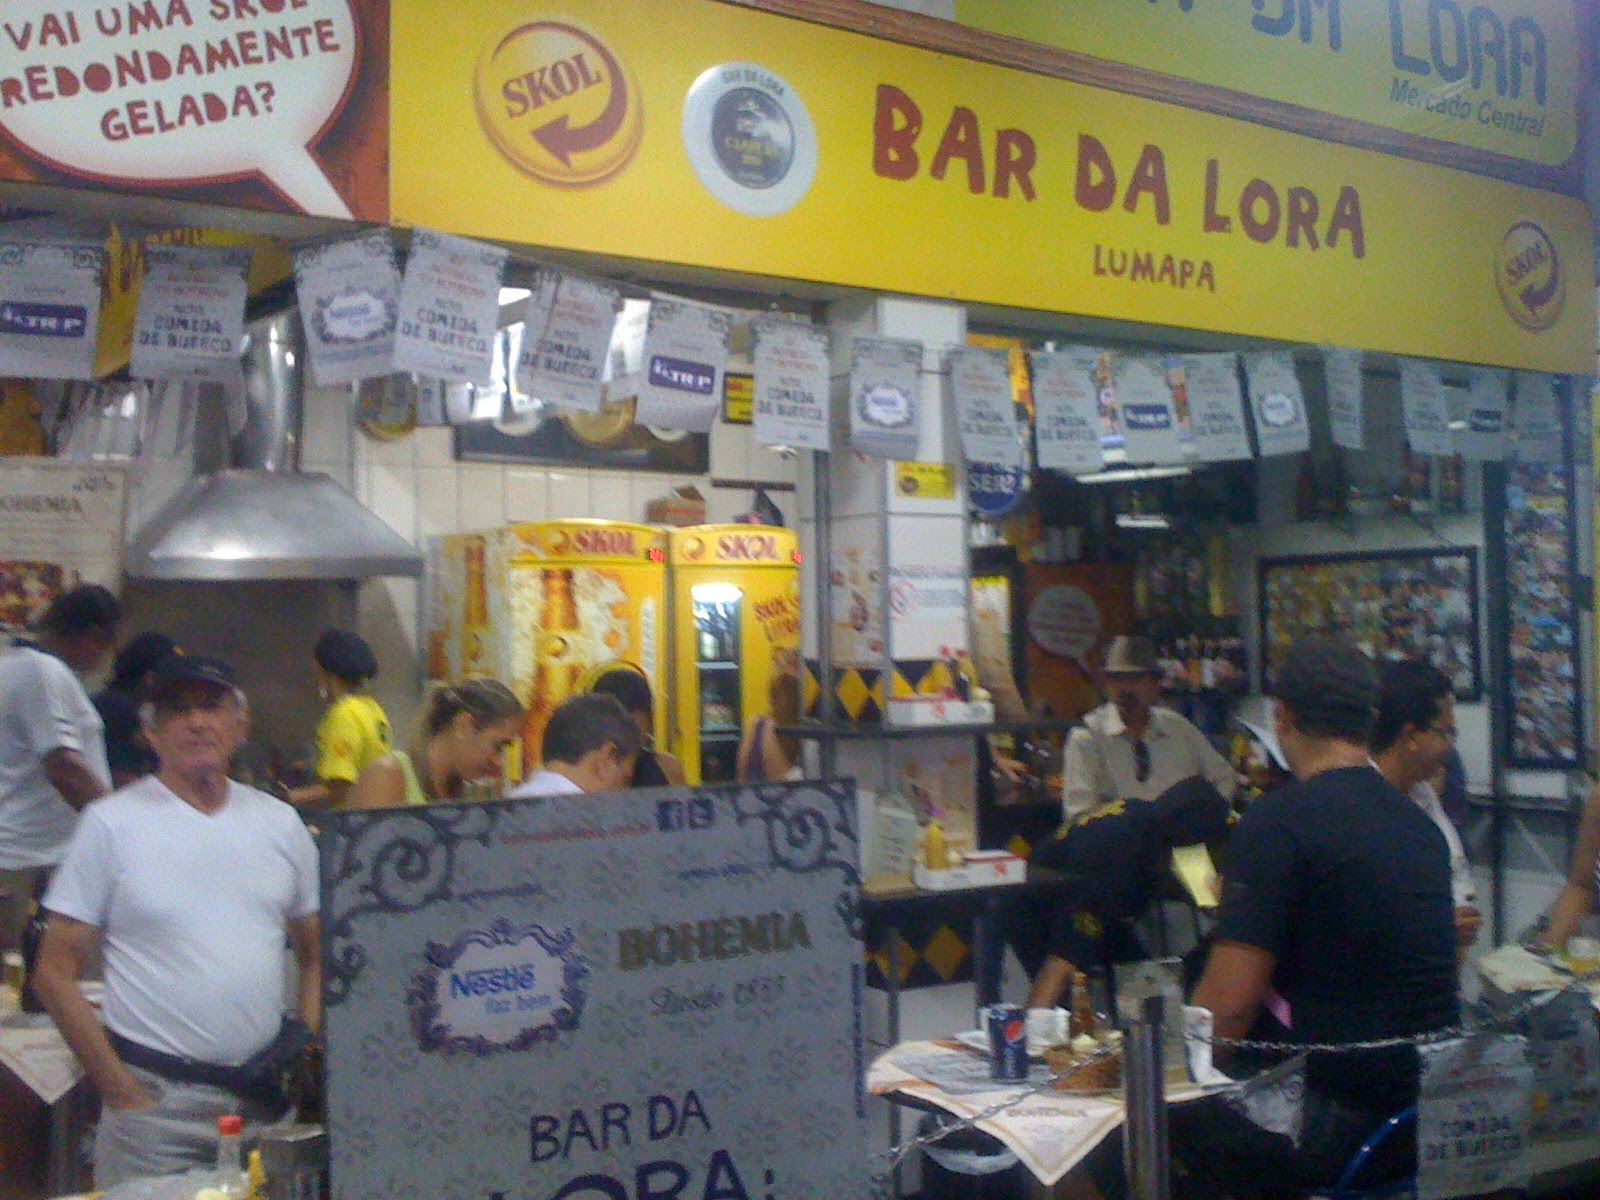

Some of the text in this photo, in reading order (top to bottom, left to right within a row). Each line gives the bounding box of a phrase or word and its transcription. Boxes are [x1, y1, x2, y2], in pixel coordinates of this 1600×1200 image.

[4, 0, 309, 51] VAI UMA SK
[1391, 0, 1546, 106] LORA
[0, 19, 340, 108] REDONDAMENTE
[502, 53, 602, 118] SKOL
[100, 82, 276, 142] GELADA?
[1390, 77, 1545, 137] Mercado Central
[873, 84, 1366, 259] BAR DA LORA
[1093, 243, 1217, 294] LUMAPA
[417, 308, 478, 333] COMIDA
[575, 531, 636, 556] SKOL
[716, 534, 778, 561] SKOL
[617, 910, 813, 972] BOHEMIA
[530, 1089, 713, 1163] BAR DA
